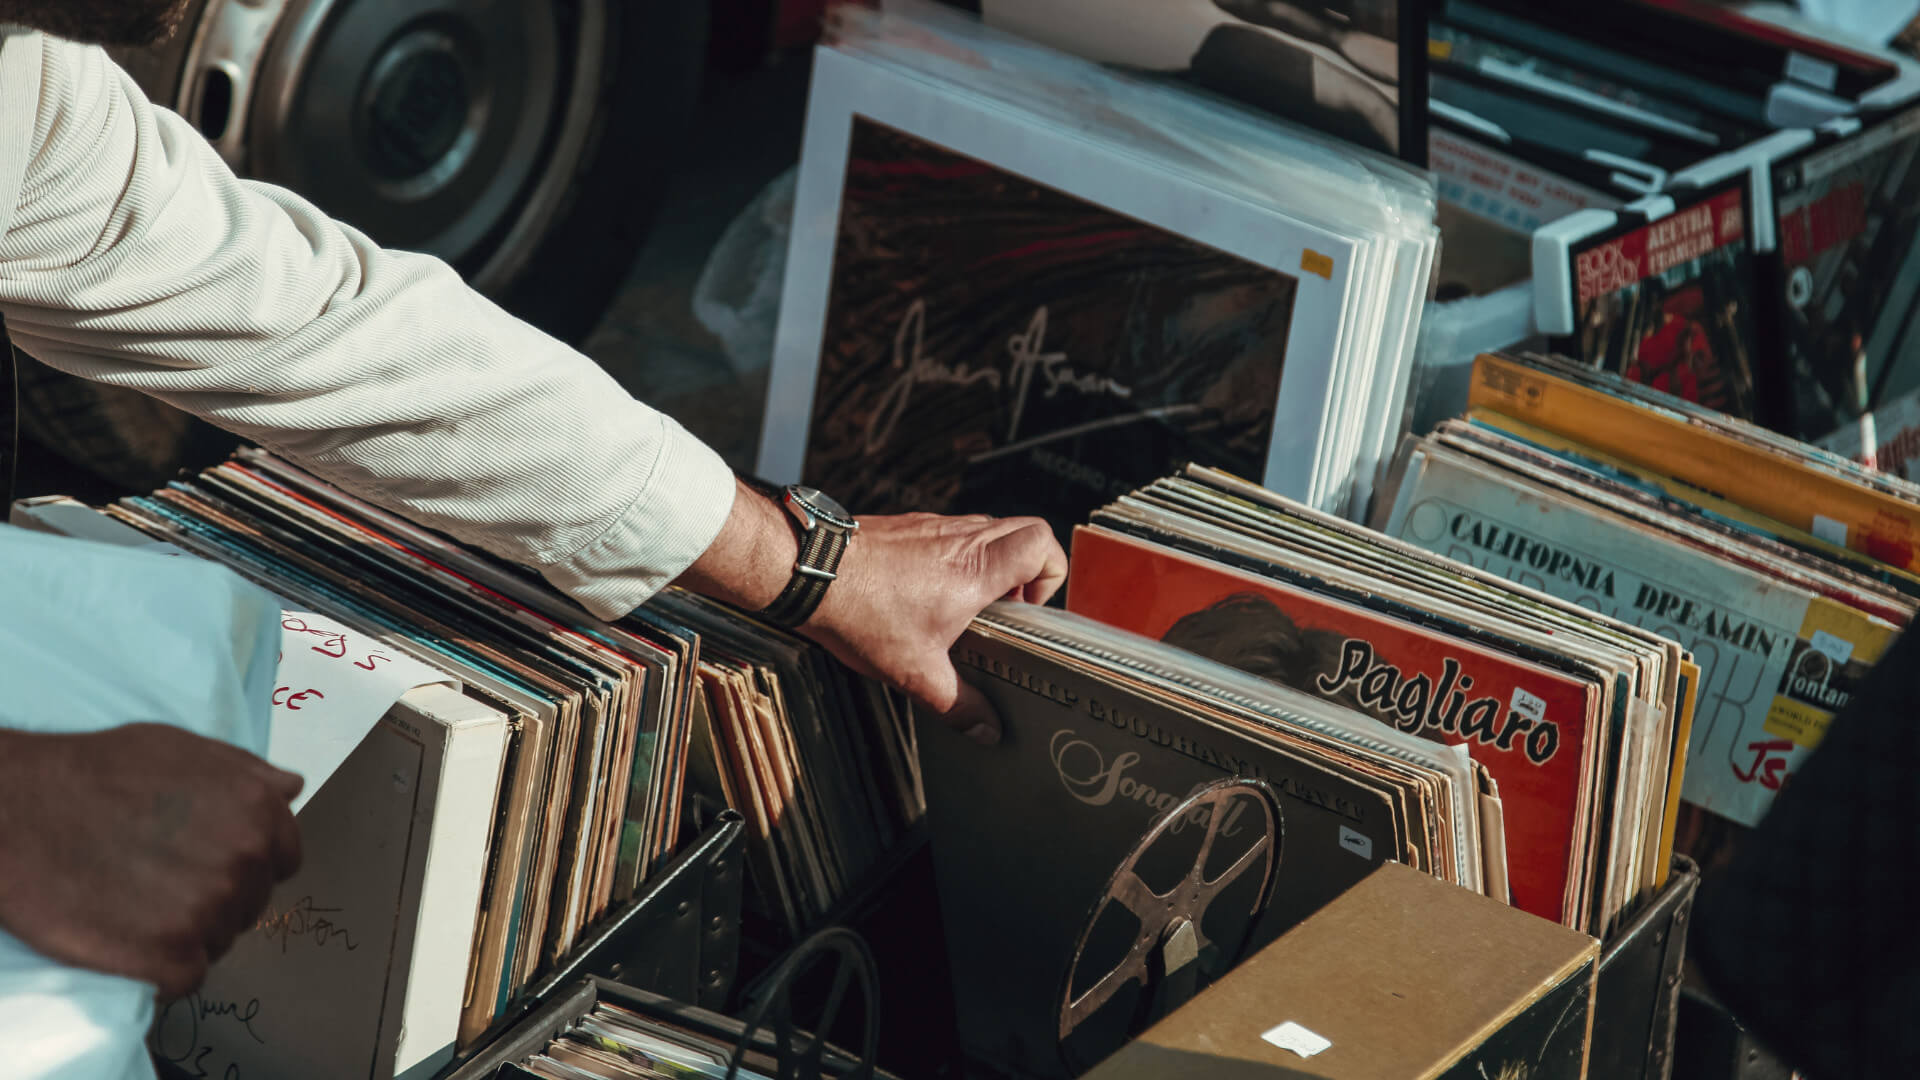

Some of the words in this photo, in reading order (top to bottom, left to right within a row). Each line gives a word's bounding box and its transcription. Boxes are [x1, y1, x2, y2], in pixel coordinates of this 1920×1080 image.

[1449, 512, 1616, 598] CALIFORNIA
[1633, 582, 1791, 656] DREAMIN'
[1316, 638, 1561, 767] Pagliaro
[1783, 650, 1854, 707] fontan
